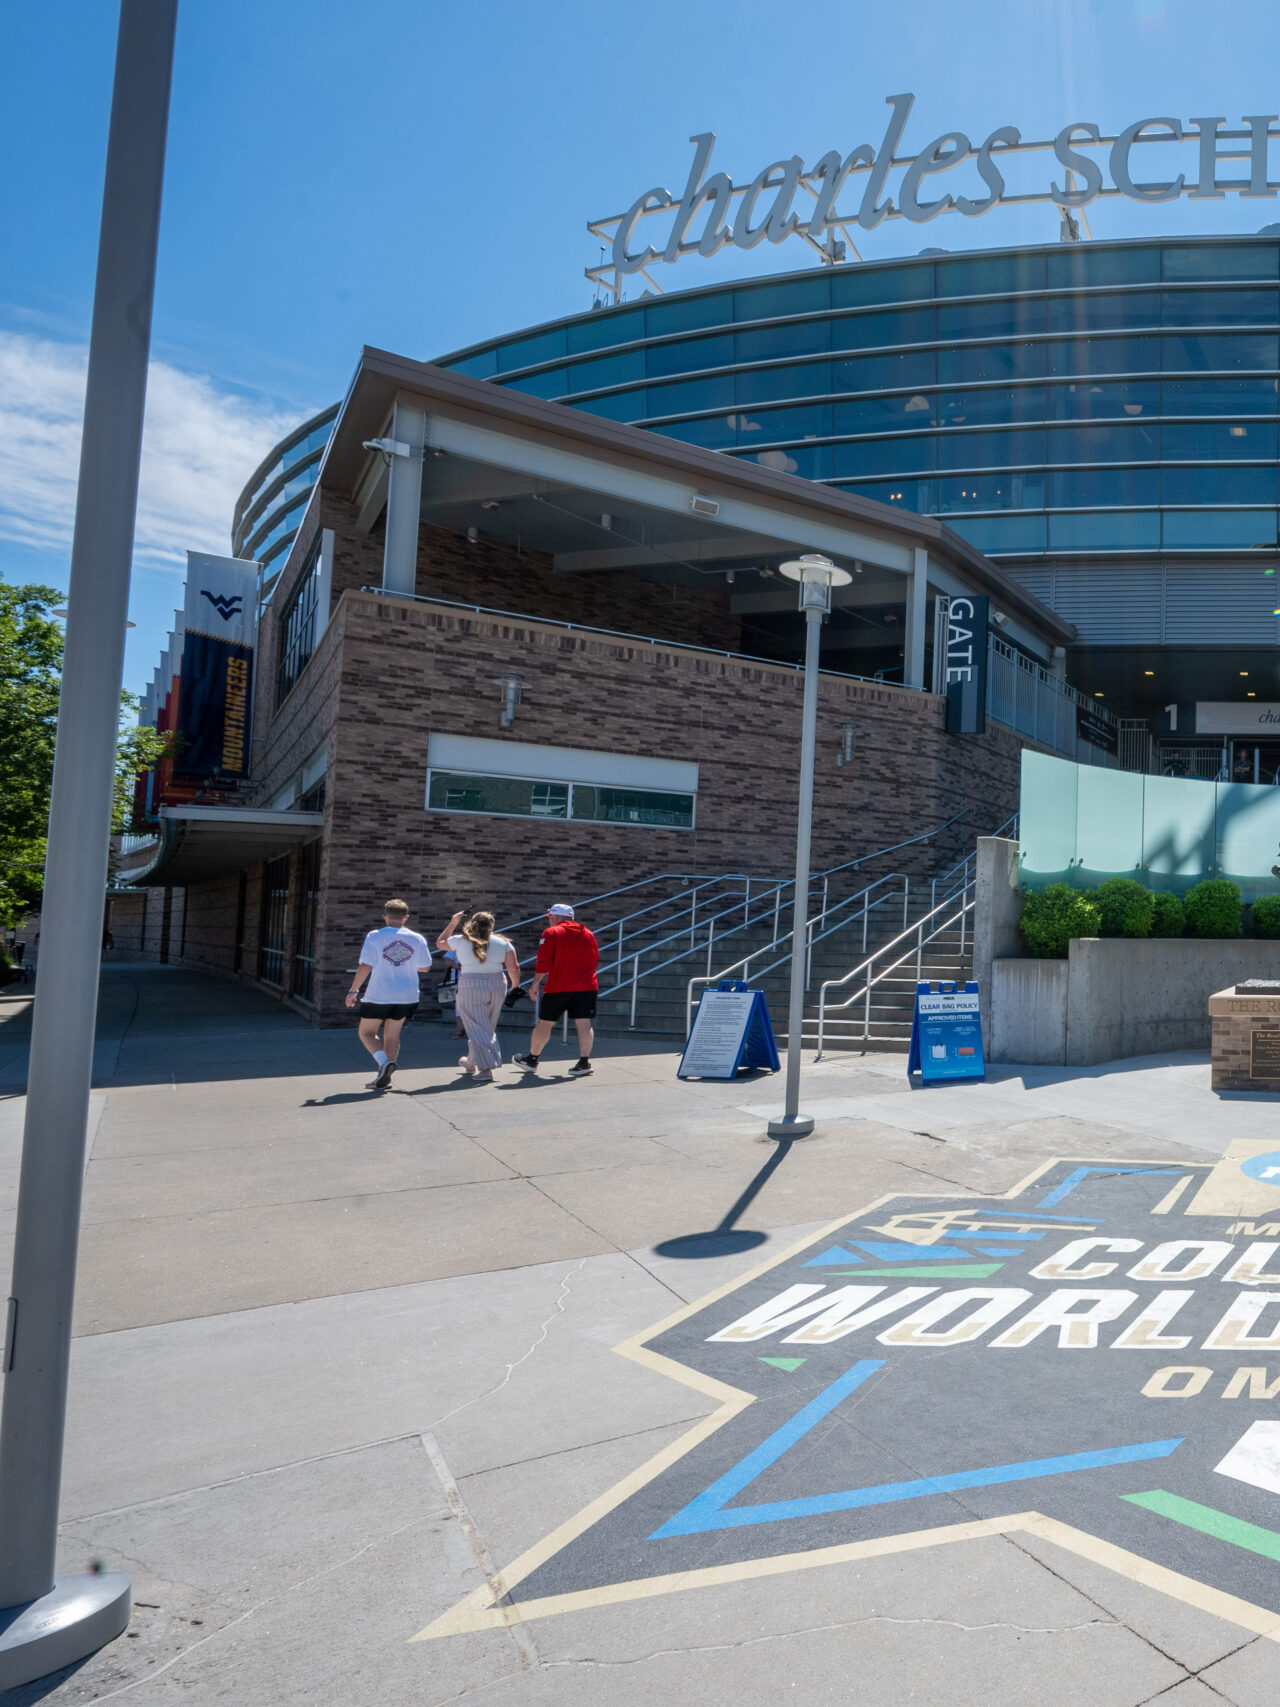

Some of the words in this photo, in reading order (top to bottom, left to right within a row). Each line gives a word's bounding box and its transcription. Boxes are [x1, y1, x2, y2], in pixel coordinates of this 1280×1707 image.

[612, 92, 1021, 273] charles
[947, 598, 974, 682] GATE
[222, 656, 248, 772] MOUNTAINEERS
[1165, 704, 1177, 730] 1
[1227, 1000, 1261, 1012] THE
